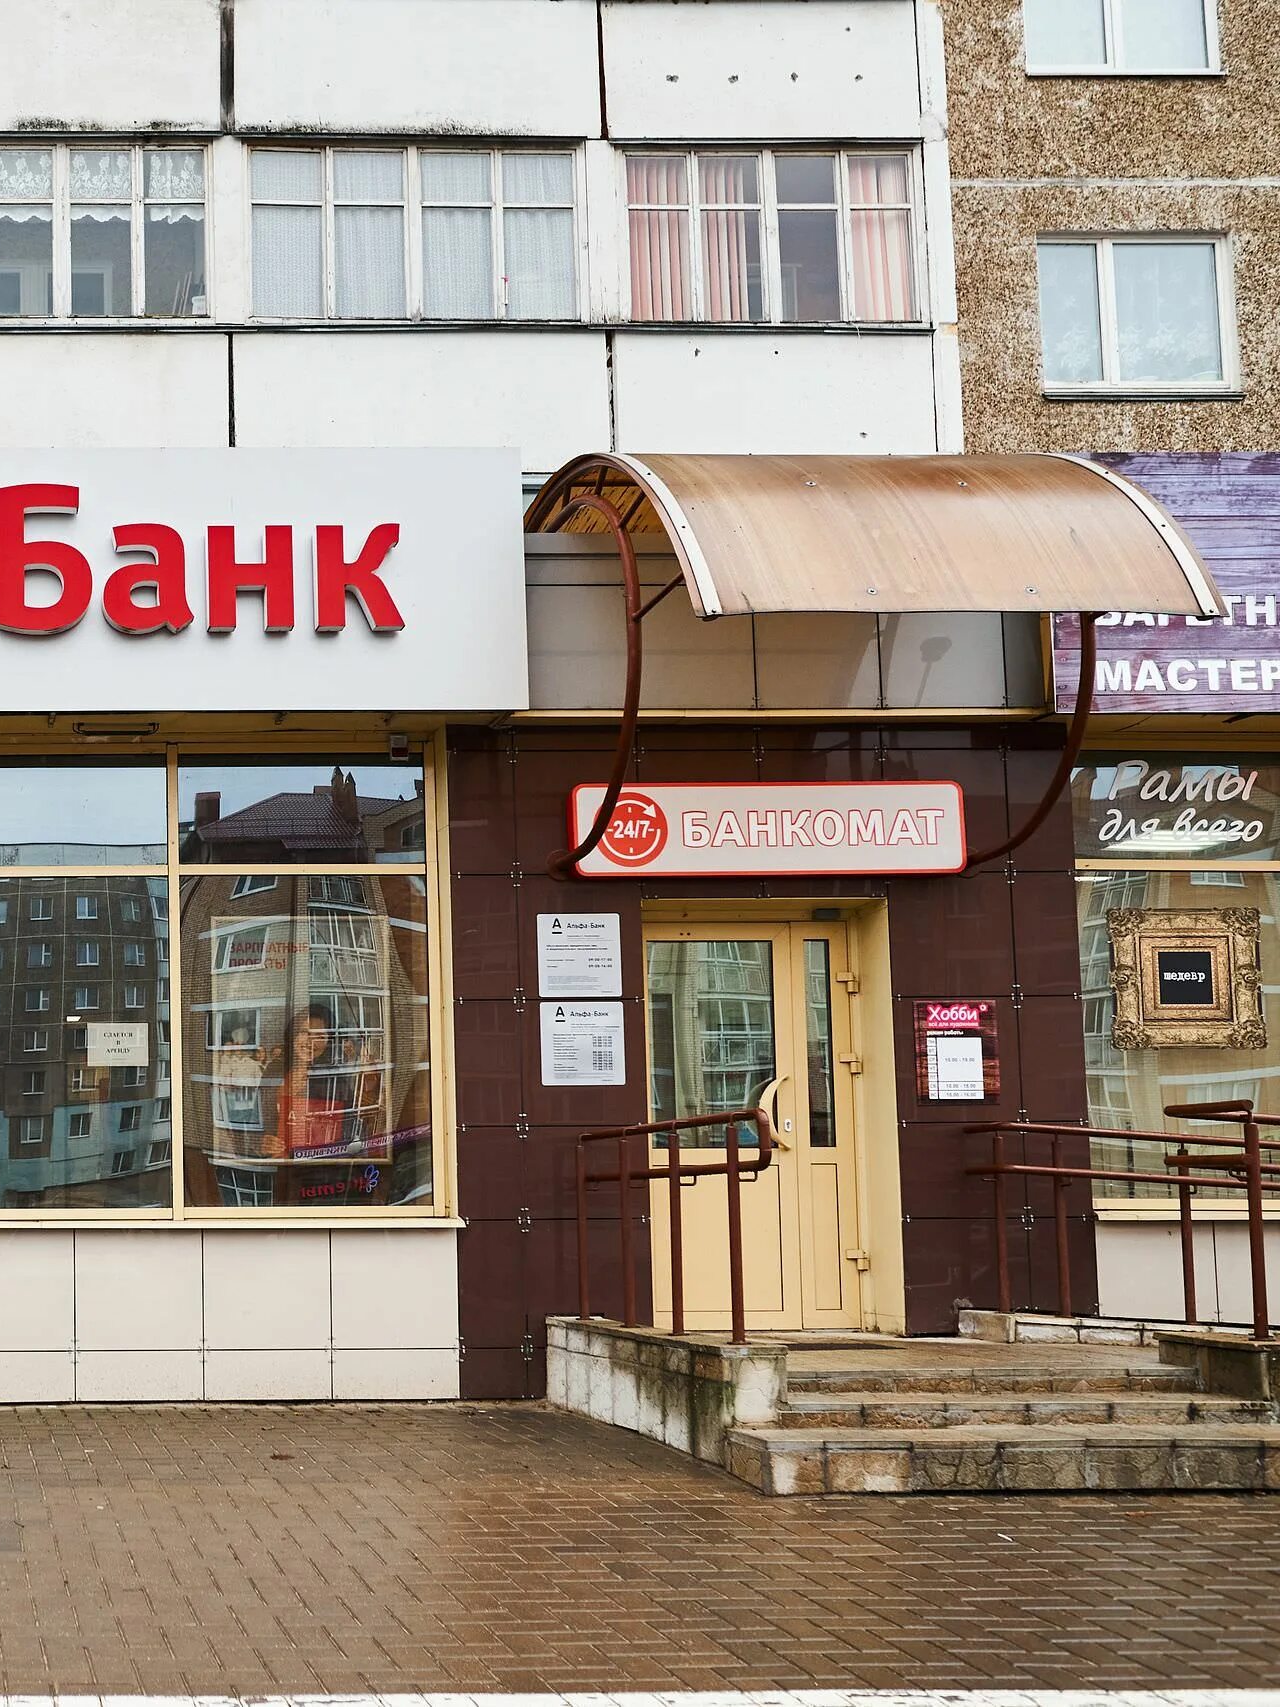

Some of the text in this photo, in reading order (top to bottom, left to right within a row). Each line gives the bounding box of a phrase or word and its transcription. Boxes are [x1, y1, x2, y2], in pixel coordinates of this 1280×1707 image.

[1108, 759, 1259, 802] Рамы
[612, 819, 650, 840] 24/7
[681, 808, 945, 848] БАНКОМАТ
[1098, 807, 1264, 842] для всего
[1163, 971, 1206, 983] шедевр
[927, 1005, 978, 1021] Хобби
